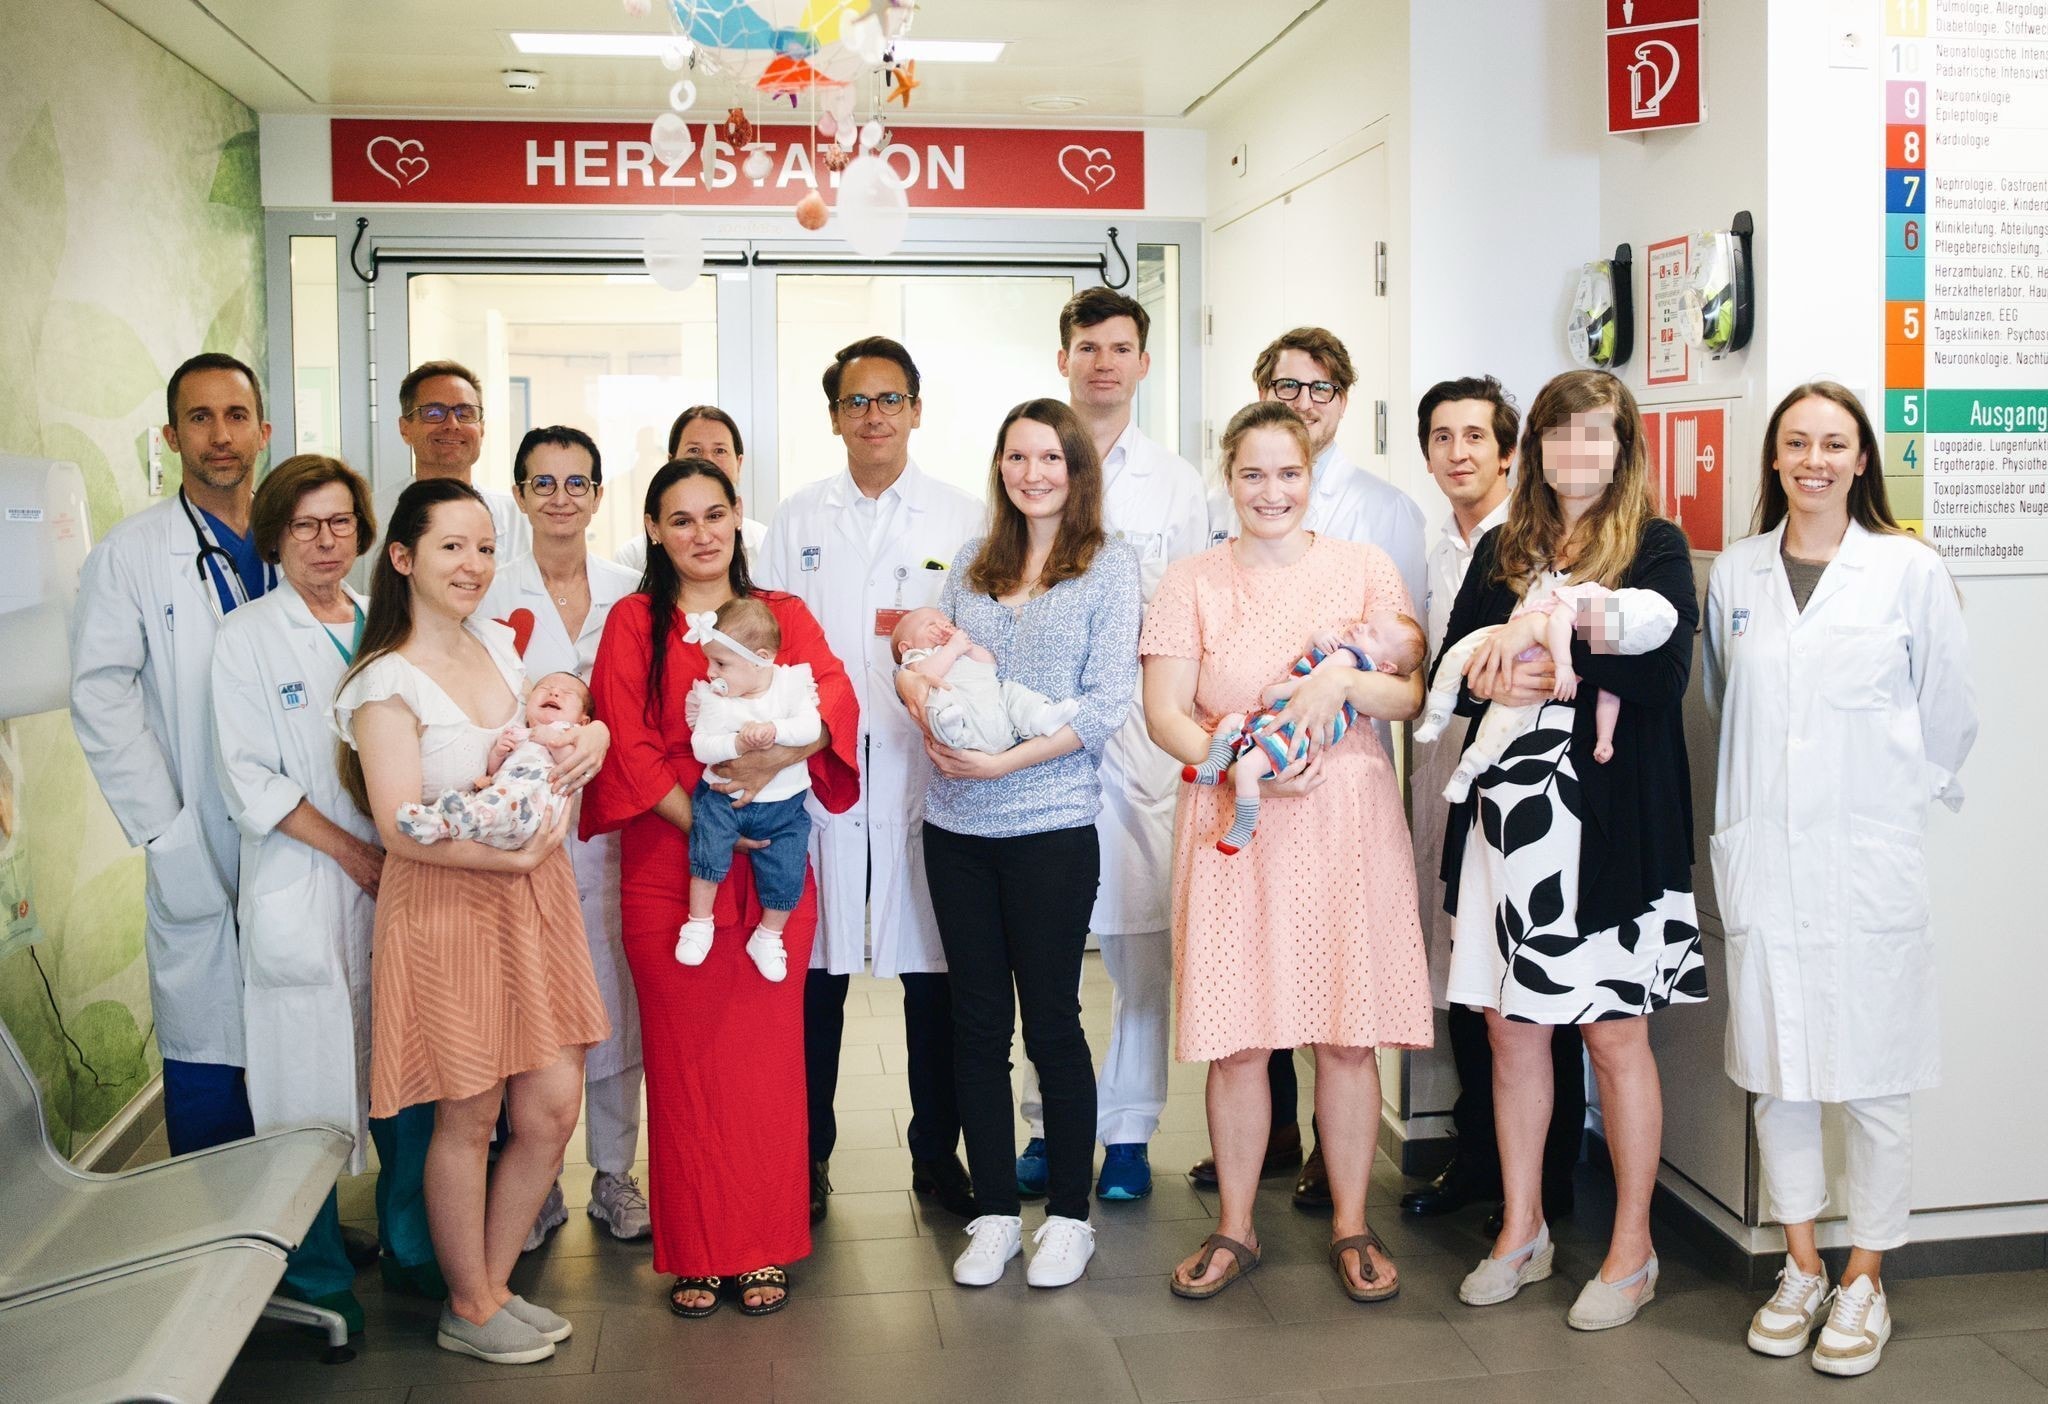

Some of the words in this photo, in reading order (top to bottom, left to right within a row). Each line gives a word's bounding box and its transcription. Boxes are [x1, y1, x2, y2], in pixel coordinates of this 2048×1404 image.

[1891, 43, 1920, 74] 10
[1904, 87, 1920, 119] 9
[1936, 88, 2011, 105] Neuroonkologie
[1936, 108, 1998, 125] Epileptologie
[1904, 131, 1920, 163] 8
[1936, 132, 1990, 149] Kardiologie
[525, 139, 965, 190] HERZSTATON
[1903, 176, 1920, 207] 7
[1904, 220, 1919, 250] 6
[2029, 284, 2048, 298] Hau
[1903, 307, 1919, 339] 5
[2000, 308, 2018, 321] EEG
[2007, 327, 2048, 343] Psychos
[1903, 395, 1919, 426] 5
[1970, 400, 2048, 432] Ausgang
[1902, 439, 1917, 469] 4
[2002, 457, 2047, 473] Physiothe
[1934, 481, 2025, 497] Toxoplasmoselabor
[2029, 482, 2046, 495] und
[1933, 499, 2015, 514] Österreichisches
[2019, 500, 2048, 516] Neuge
[1933, 525, 1987, 539] Milchküche
